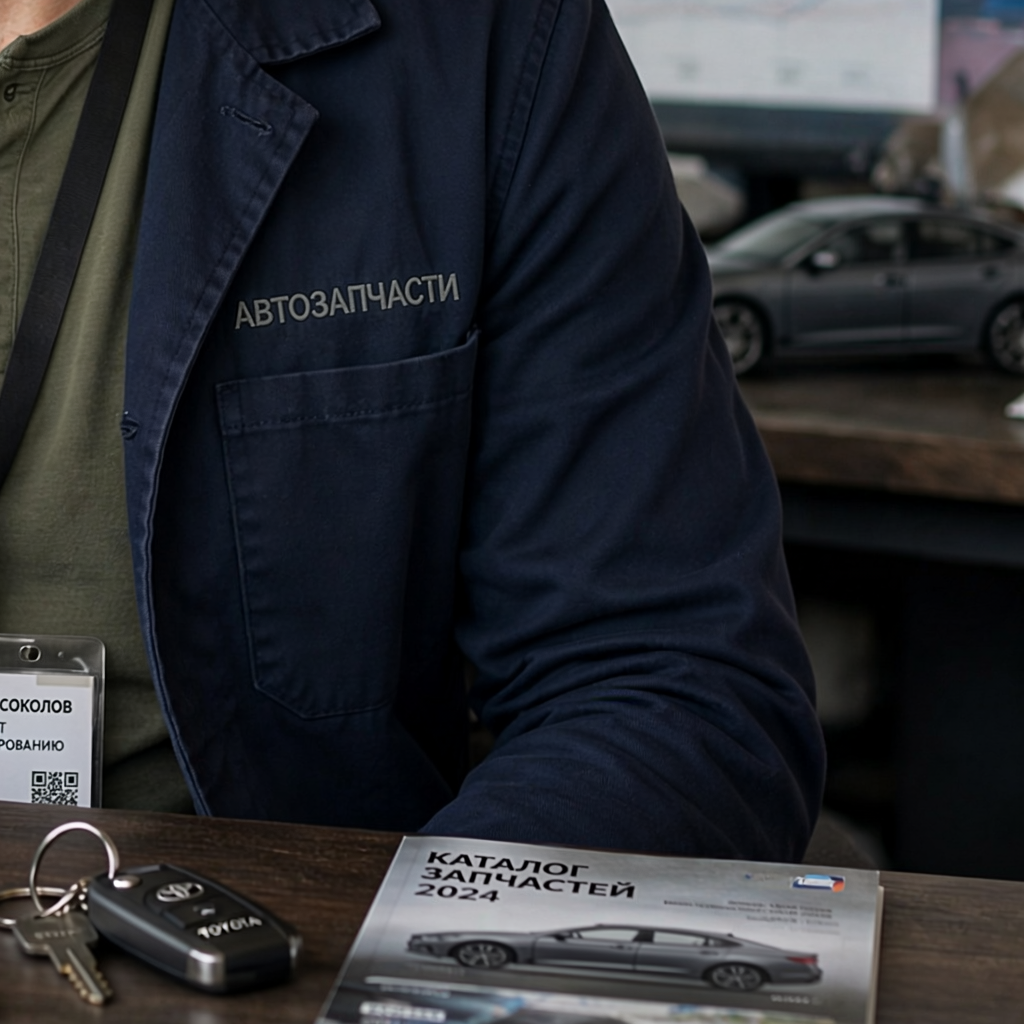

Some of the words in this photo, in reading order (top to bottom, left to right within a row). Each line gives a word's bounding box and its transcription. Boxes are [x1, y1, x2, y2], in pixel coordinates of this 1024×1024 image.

[235, 273, 460, 329] АВТОЗАПЧАСТИ
[0, 698, 73, 714] СОКОЛОВ
[427, 851, 590, 877] КАТАЛОГ
[414, 883, 500, 902] 2024
[420, 866, 636, 899] ЗАПЧАСТЕЙ
[197, 916, 262, 939] TOYOTA
